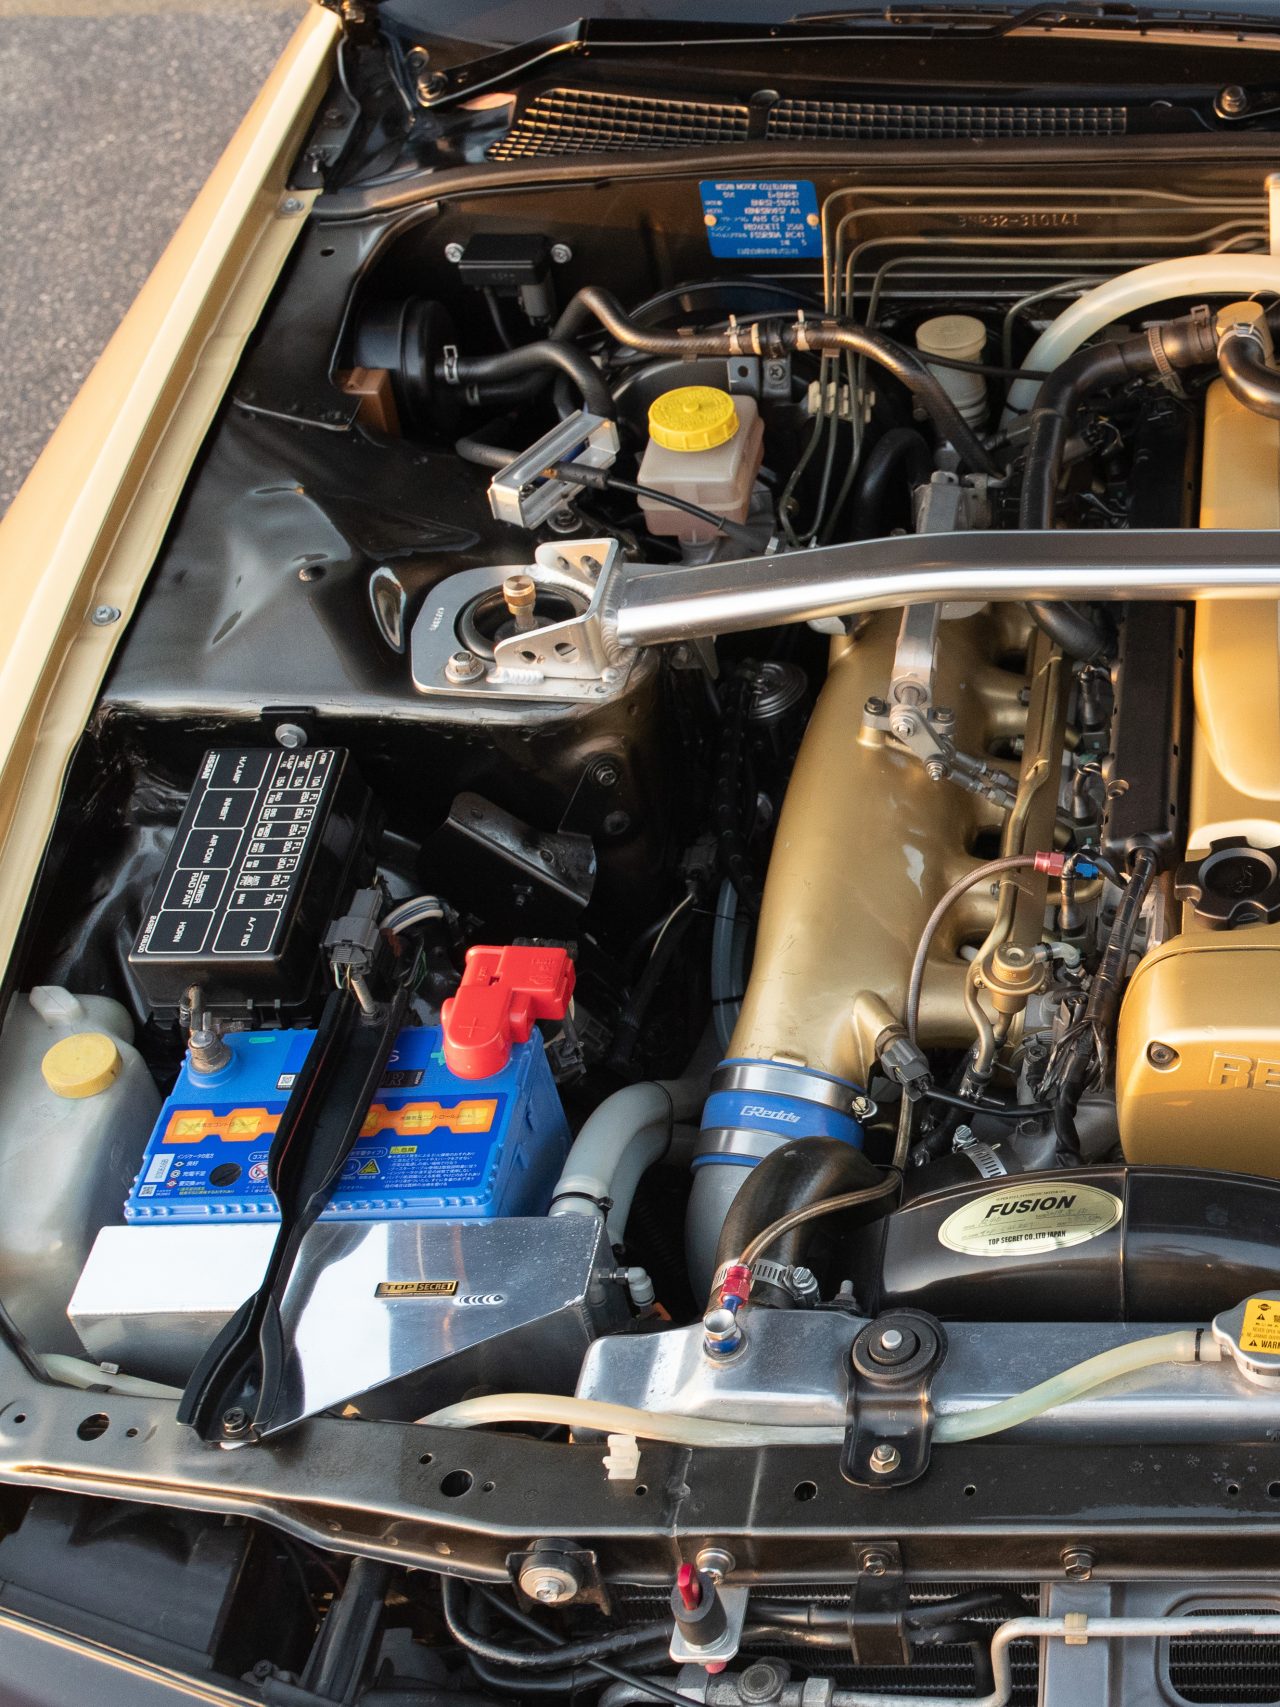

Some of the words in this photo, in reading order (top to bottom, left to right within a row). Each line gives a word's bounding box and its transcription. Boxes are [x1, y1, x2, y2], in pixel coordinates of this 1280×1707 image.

[231, 756, 247, 783] H/LAMP
[308, 793, 318, 801] FL
[303, 809, 312, 817] FL
[297, 826, 307, 834] FL
[208, 834, 219, 846] AIR
[291, 842, 301, 850] FL
[202, 848, 214, 862] CON
[285, 858, 295, 867] FL
[187, 872, 199, 887] RAD
[279, 875, 289, 884] FL
[192, 874, 209, 903] BLOWER
[181, 889, 193, 904] FAN
[273, 894, 283, 902] FL
[245, 916, 256, 931] A/T
[171, 922, 187, 942] HORN
[240, 934, 250, 946] IND
[740, 1105, 800, 1123] GReddy
[984, 1194, 1078, 1219] FUSION
[988, 1236, 1000, 1246] TOP
[1001, 1235, 1023, 1243] SECRET
[418, 1282, 453, 1291] SECRET
